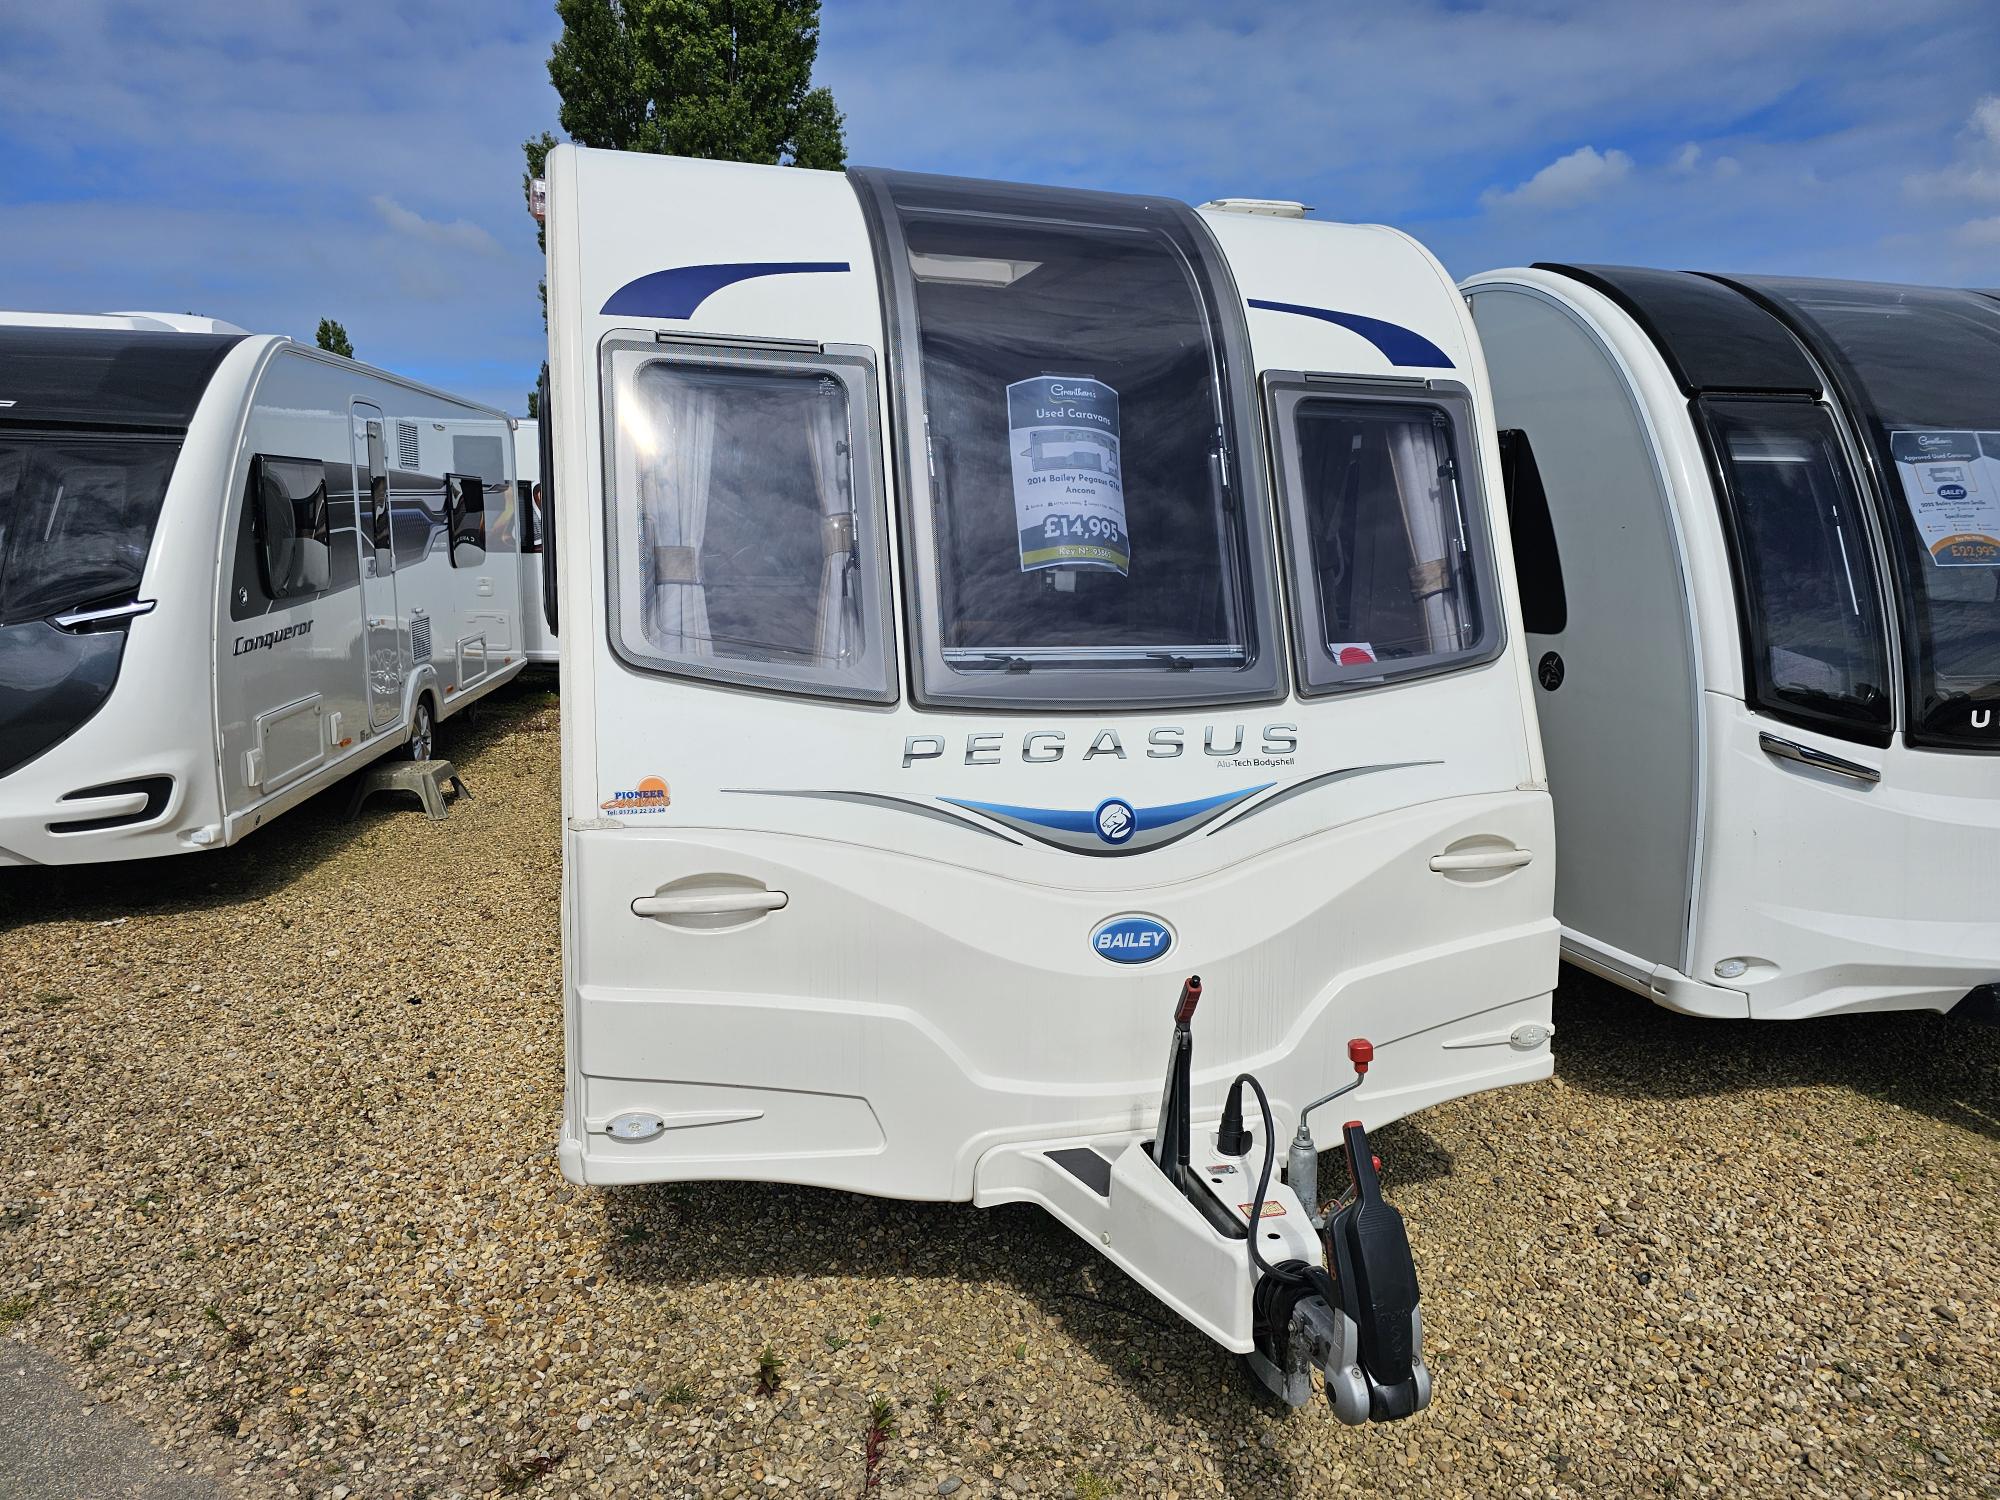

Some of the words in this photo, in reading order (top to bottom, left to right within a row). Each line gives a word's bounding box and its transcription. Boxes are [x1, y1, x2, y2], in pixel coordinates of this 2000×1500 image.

[1036, 408, 1064, 418] Used
[1067, 408, 1111, 426] Caravans
[1027, 476, 1046, 485] 2014
[1049, 473, 1076, 483] Bailey
[1078, 473, 1108, 485] Pegasus
[1065, 485, 1096, 495] Ancona
[1045, 517, 1118, 542] £14,995
[1059, 547, 1076, 555] Key
[232, 619, 314, 656] Conqueror
[901, 723, 1298, 768] PEGASUS
[1216, 759, 1252, 768] Alu-Tech
[1253, 757, 1295, 768] Bodyshell
[615, 790, 664, 799] PIONEER
[1097, 931, 1166, 949] BAILEY
